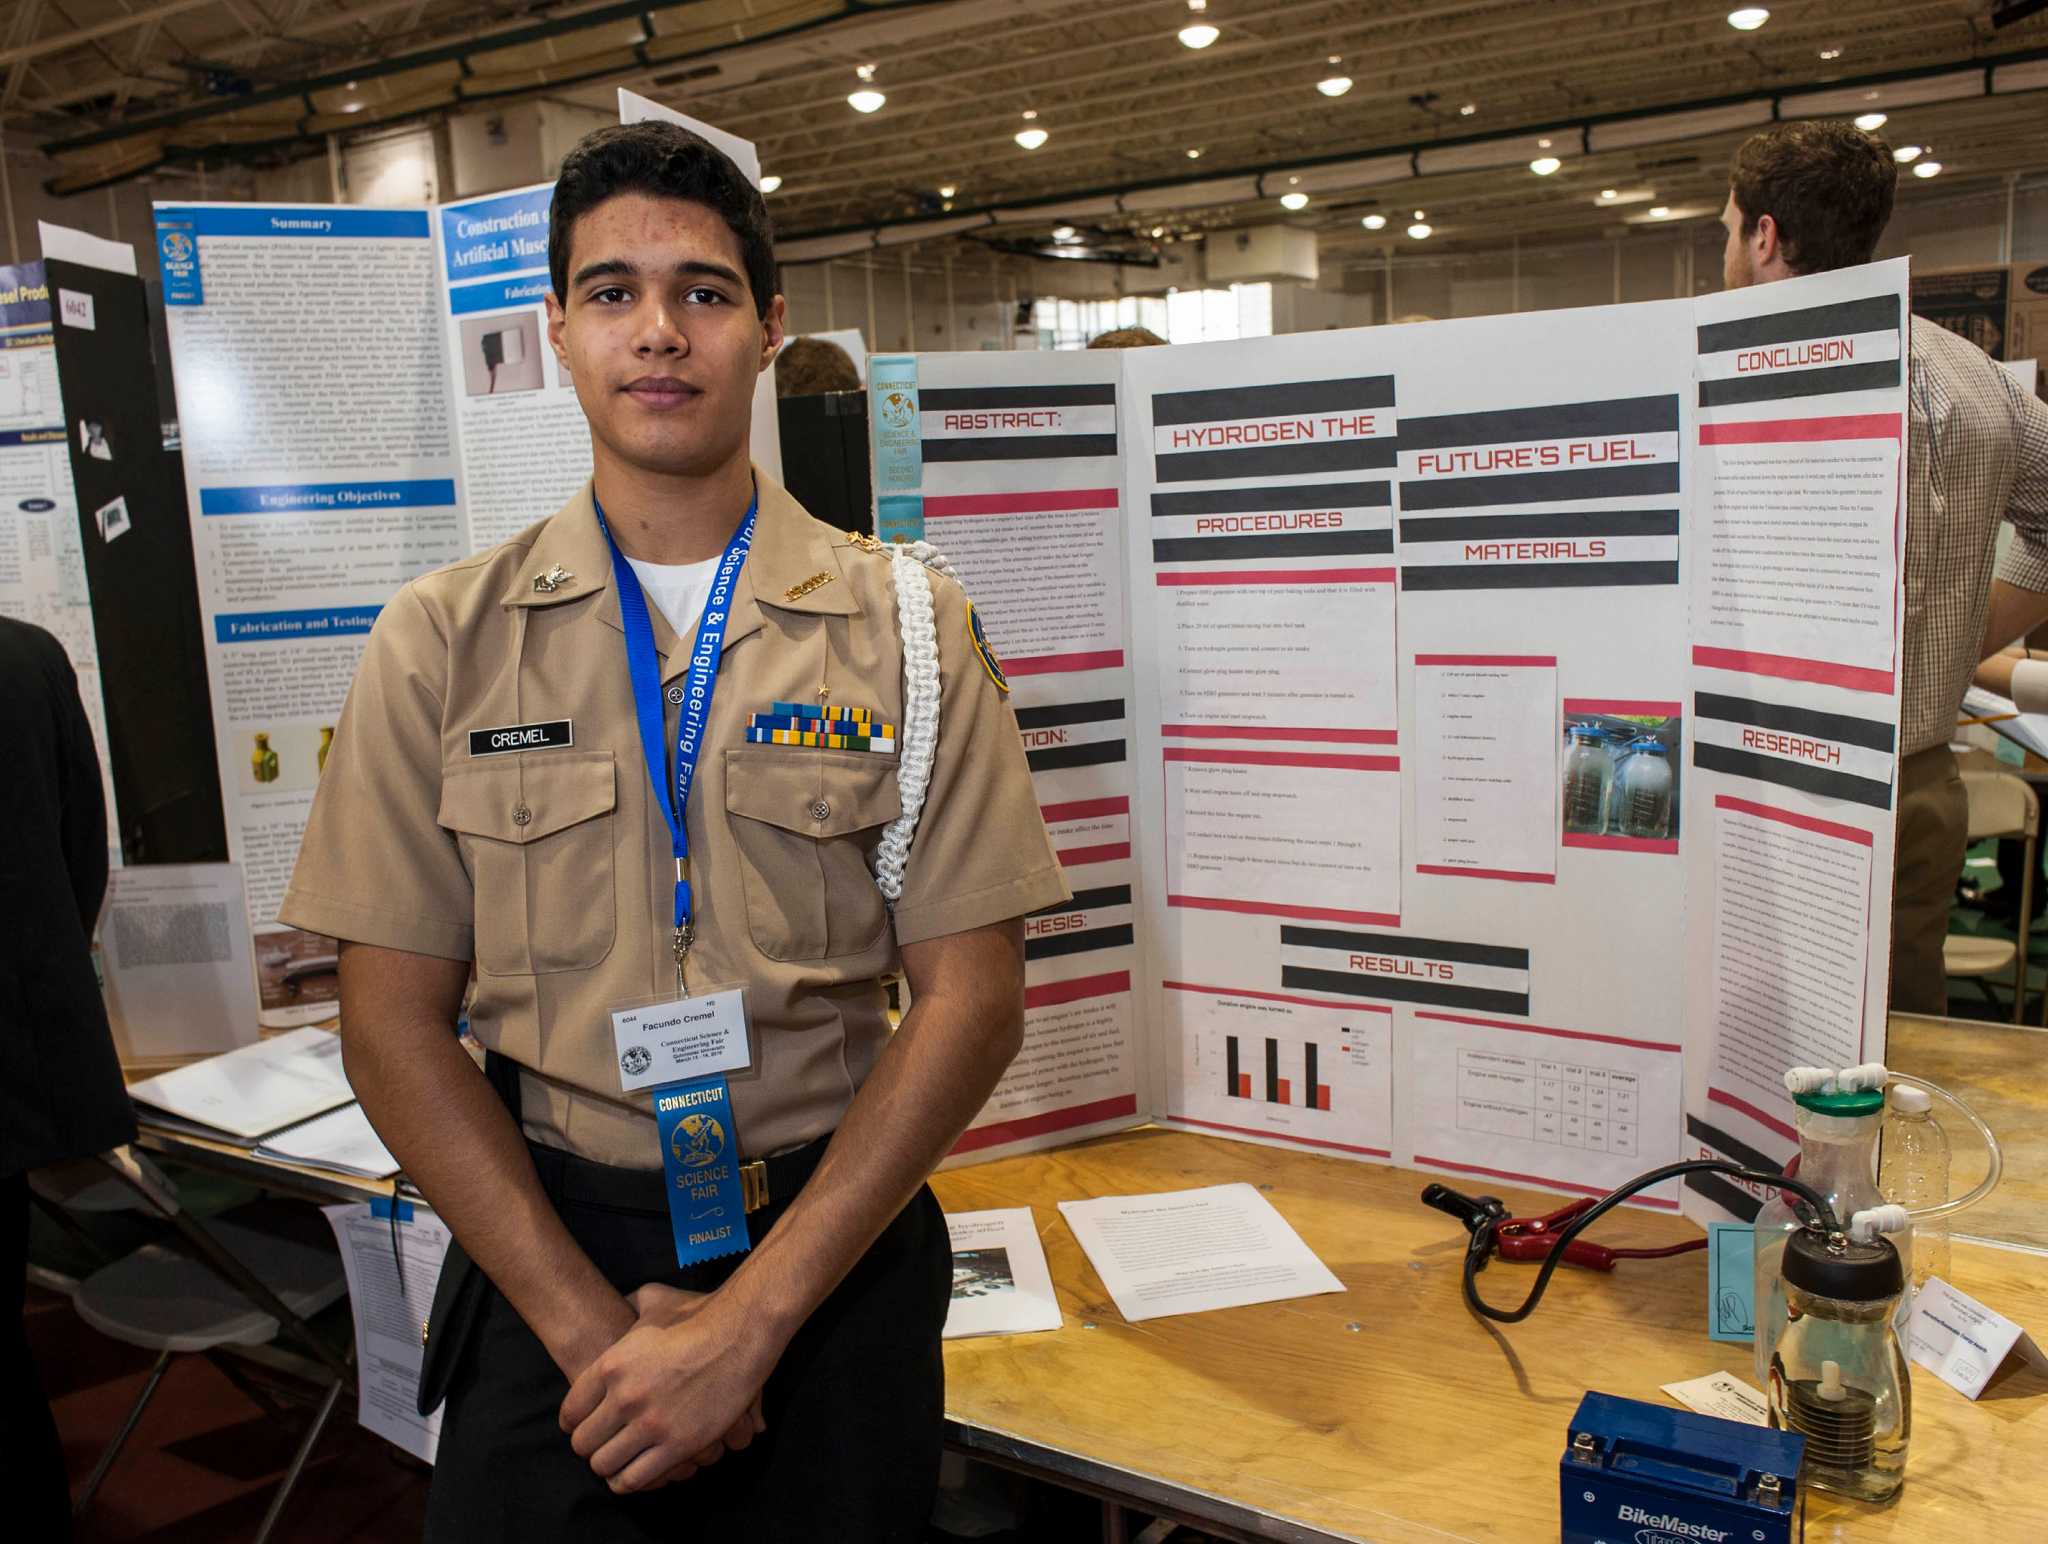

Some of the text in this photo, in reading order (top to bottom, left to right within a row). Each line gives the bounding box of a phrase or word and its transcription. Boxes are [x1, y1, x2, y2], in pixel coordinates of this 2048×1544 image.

[271, 217, 332, 233] Summary
[457, 209, 540, 239] Construction
[453, 242, 509, 268] Artificial
[65, 300, 87, 317] 6042
[1738, 339, 1854, 372] CONCLUSION
[945, 411, 1062, 431] ABSTRACT:
[1173, 415, 1376, 448] HYDROGEN THE
[1417, 439, 1656, 475] FUTURE'S FUEL.
[260, 489, 401, 507] Engineering Objectives
[1197, 511, 1343, 534] PROCEDURES
[1465, 541, 1606, 561] MATERIALS
[711, 547, 749, 606] Science
[231, 615, 374, 635] Fabrication and Testing
[704, 611, 724, 626] &
[679, 632, 720, 756] Engineering
[491, 728, 550, 748] CREMEL
[1743, 729, 1841, 765] RESEARCH
[678, 762, 693, 799] Fair
[1350, 954, 1454, 980] RESULTS
[622, 1015, 637, 1023] 6044
[642, 1011, 715, 1031] Facundo Cremel
[660, 1034, 699, 1048] Connecticut
[699, 1030, 722, 1041] Science
[672, 1041, 710, 1053] Engineering
[659, 1087, 723, 1112] CONNECTICUT
[676, 1165, 729, 1189] SCIENCE
[691, 1183, 719, 1201] FAIR
[688, 1225, 732, 1246] FINALIST
[1617, 1504, 1729, 1542] BikeMaster
